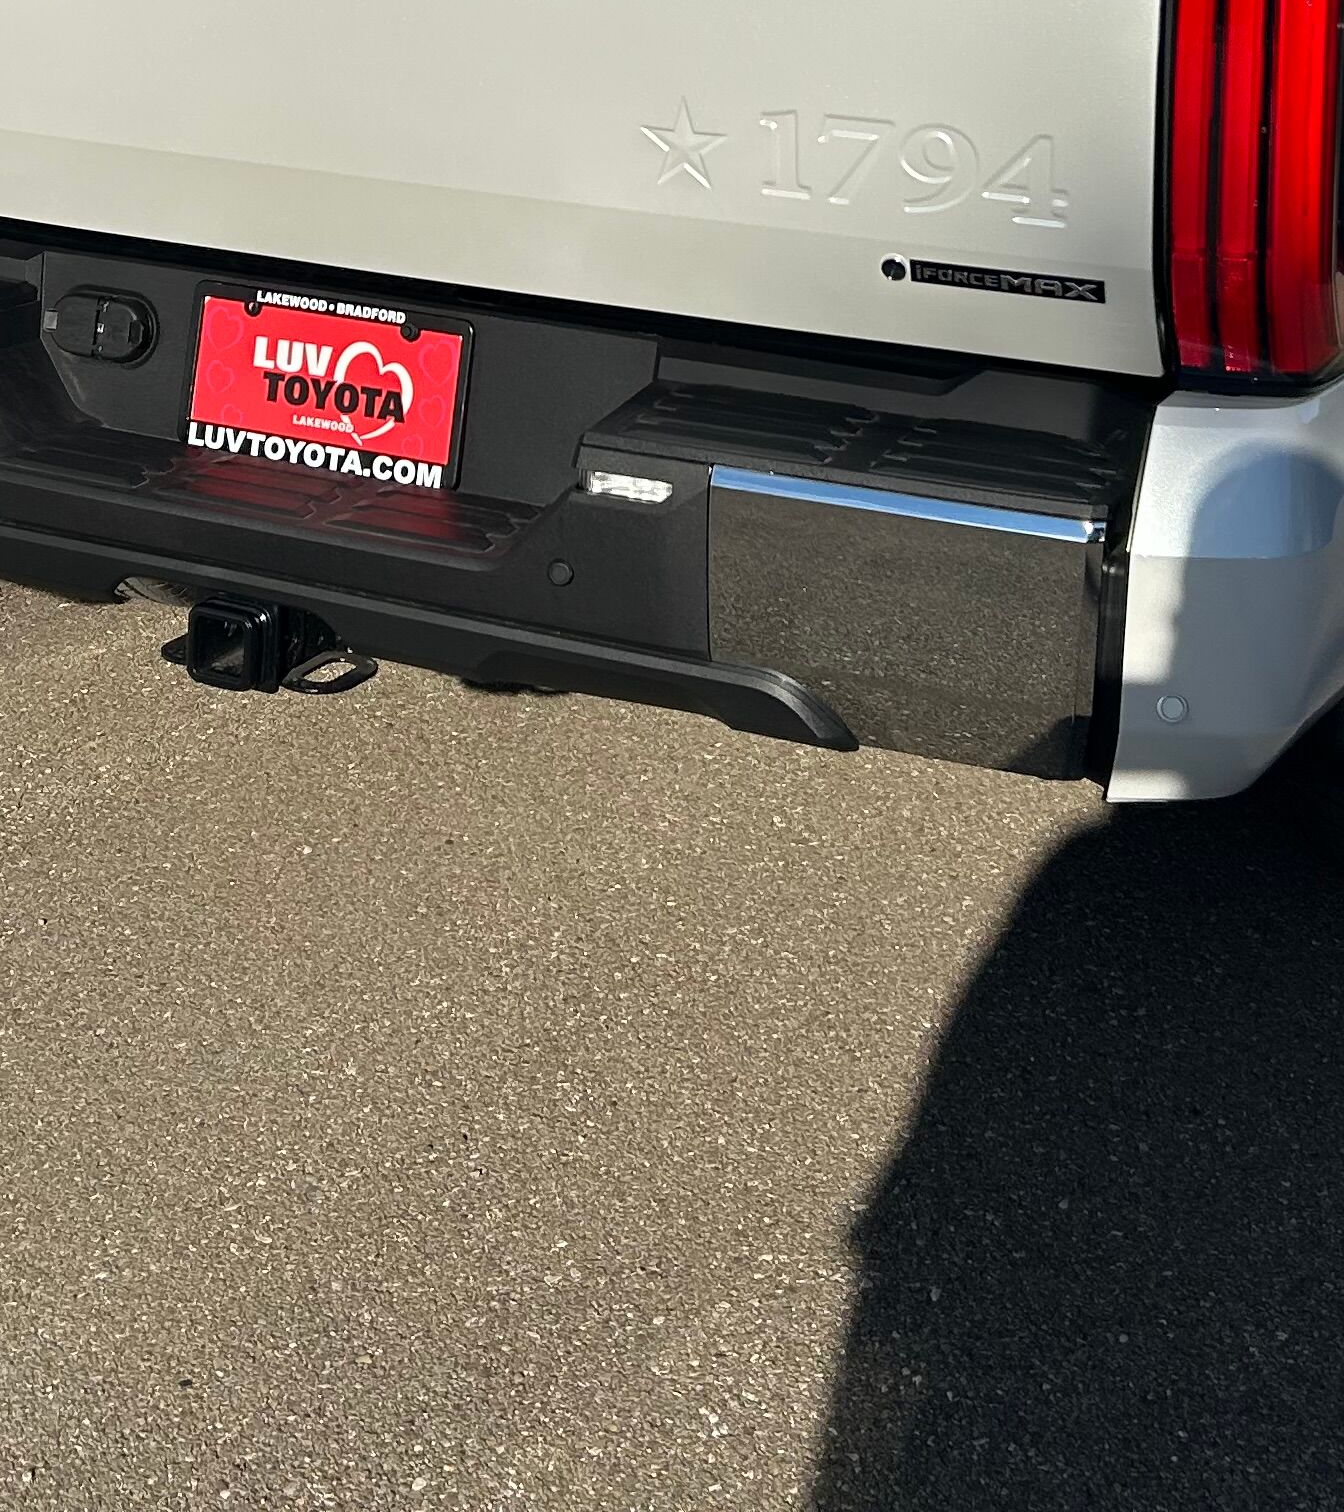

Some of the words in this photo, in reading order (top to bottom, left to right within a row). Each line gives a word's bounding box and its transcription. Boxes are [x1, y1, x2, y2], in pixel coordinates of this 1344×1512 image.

[758, 108, 1071, 229] 1794
[256, 290, 328, 313] LAKEWOOD
[336, 302, 406, 325] BRADFORD
[252, 335, 334, 377] LUV
[262, 371, 406, 424] TOYOTA
[292, 414, 354, 434] LAKEWOOD
[187, 422, 443, 490] LUVTOYOTA.COM
